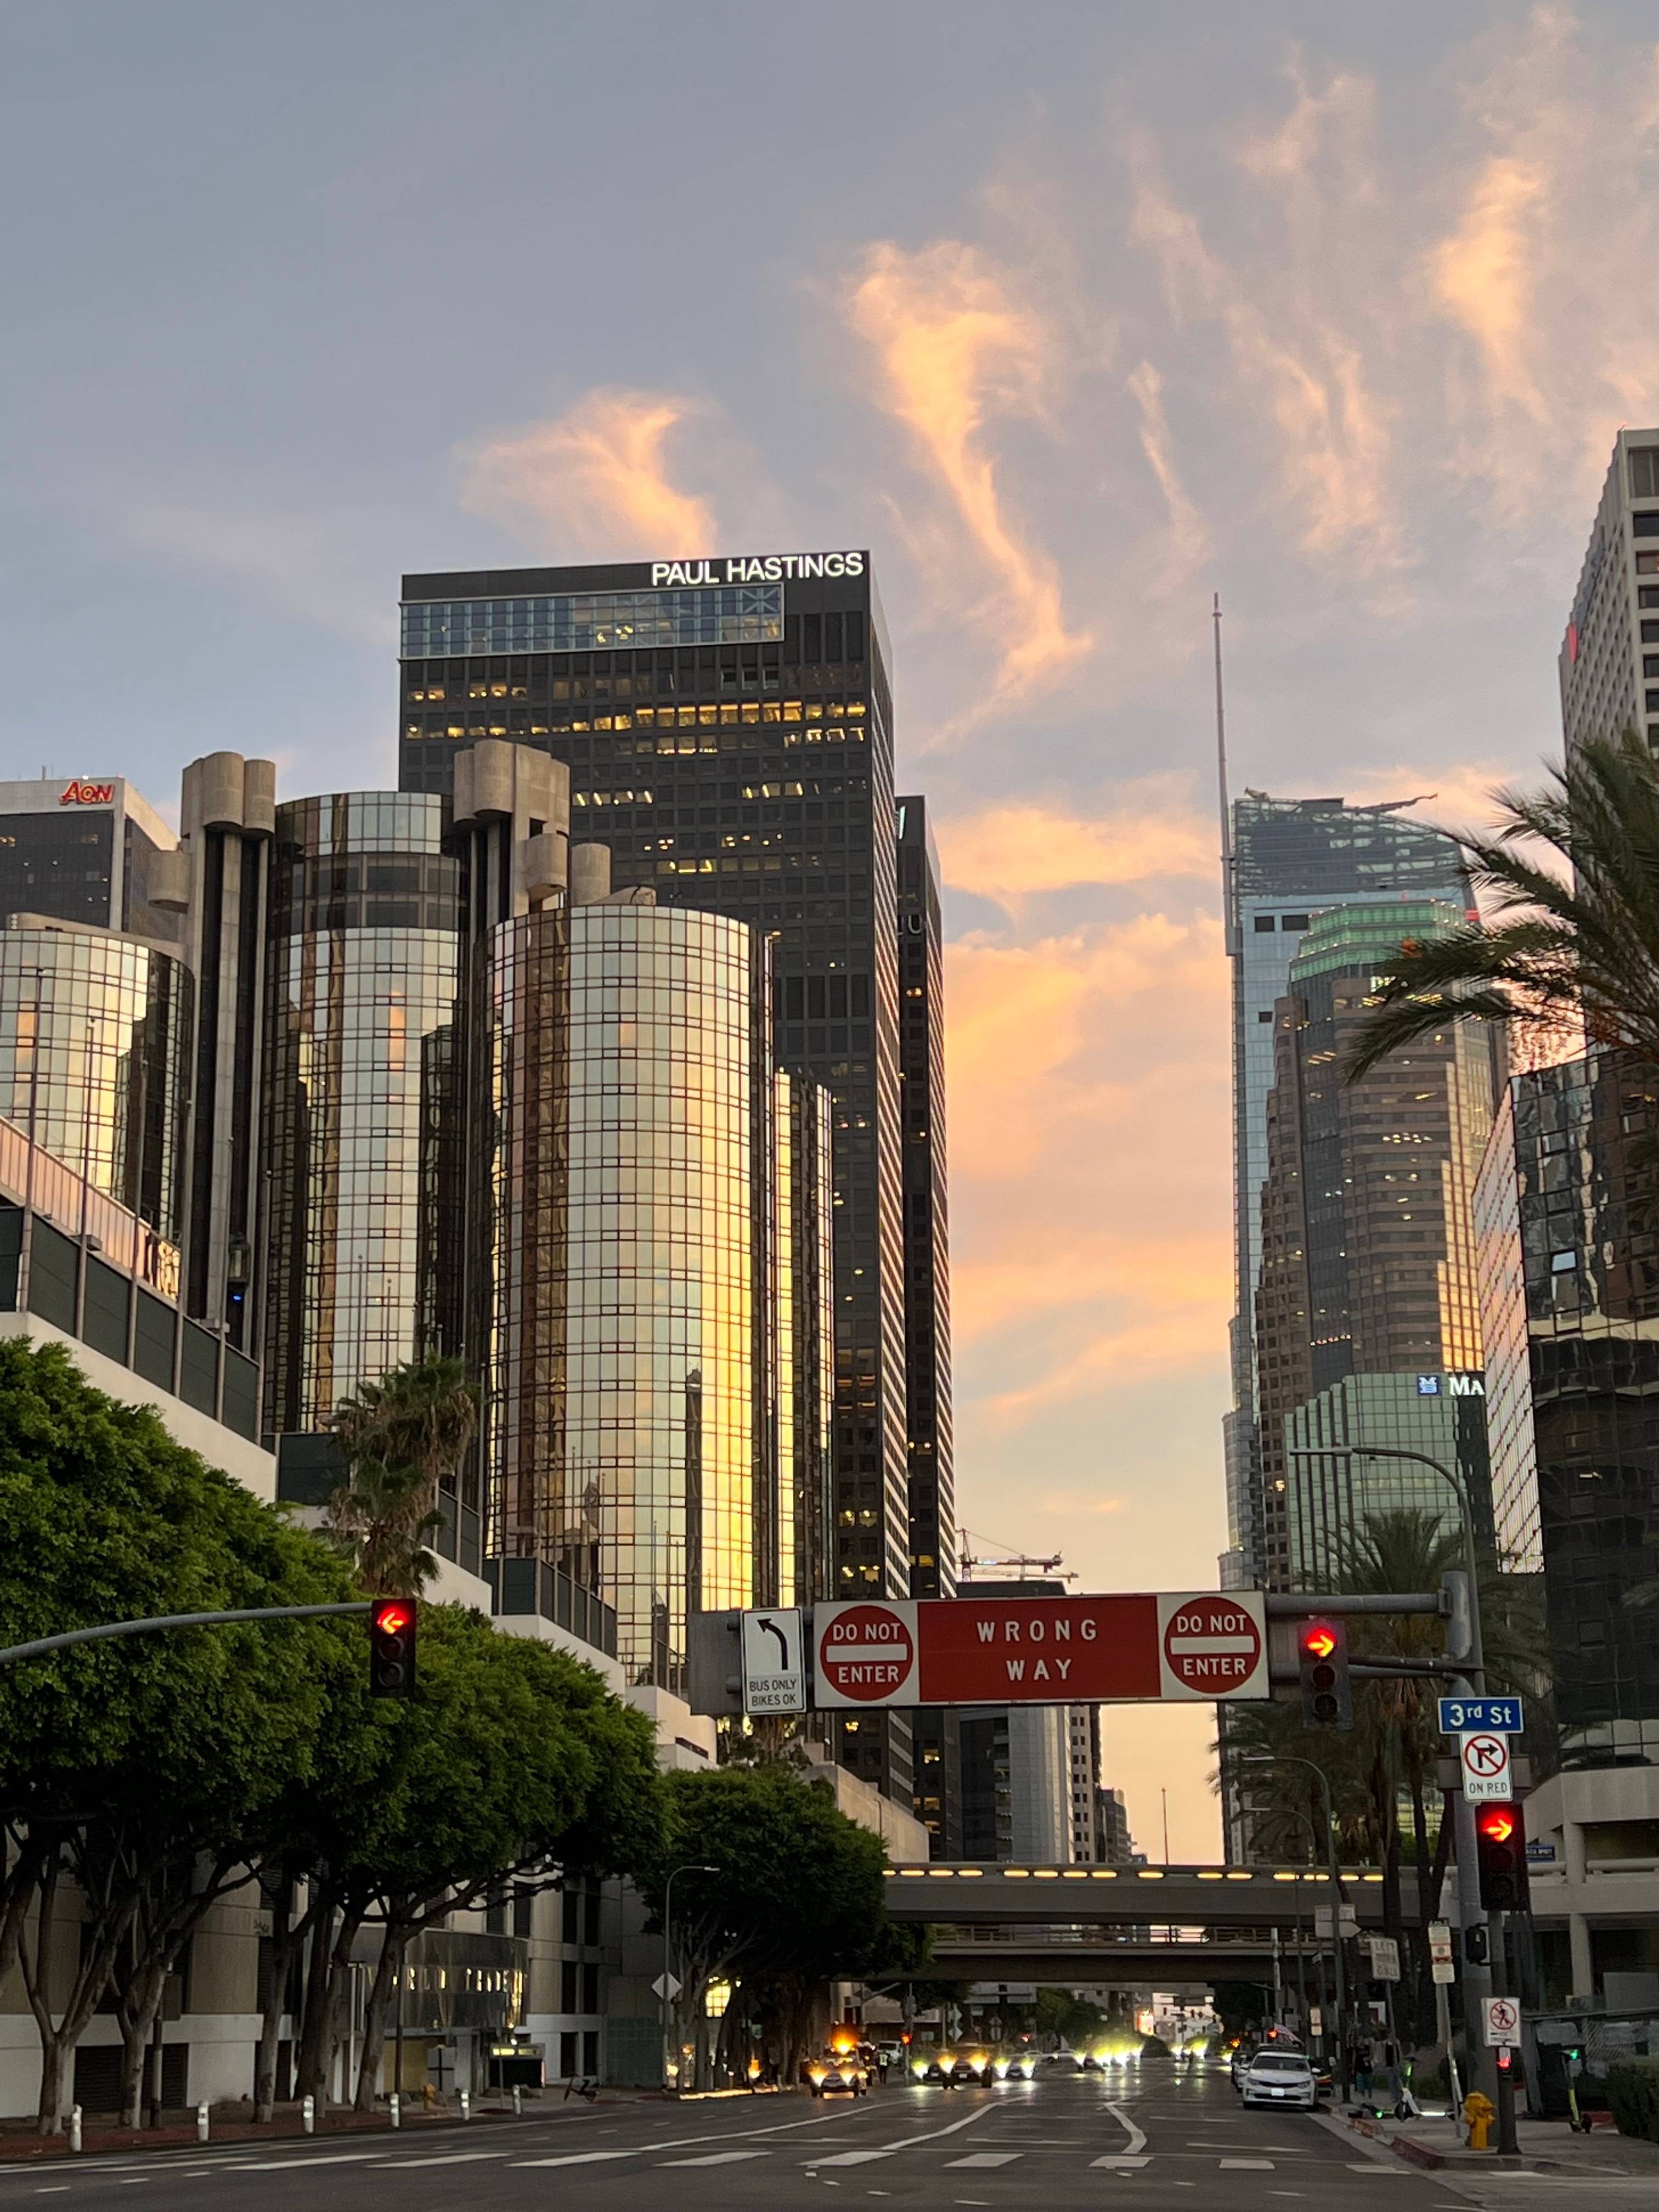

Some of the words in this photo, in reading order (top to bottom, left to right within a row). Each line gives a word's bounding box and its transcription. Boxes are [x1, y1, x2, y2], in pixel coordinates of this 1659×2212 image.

[651, 561, 719, 586] PAUL
[727, 552, 864, 582] HASTINGS
[833, 1624, 857, 1641] DO
[865, 1623, 901, 1640] NOT
[977, 1619, 1097, 1642] WRONG
[1177, 1615, 1202, 1633] DO
[1210, 1615, 1246, 1632] NOT
[838, 1666, 899, 1683] ENTER
[1006, 1658, 1071, 1680] WAY
[1183, 1658, 1246, 1676] ENTER
[749, 1680, 769, 1691] BUS
[772, 1679, 797, 1690] ONLY
[752, 1694, 780, 1707] BIKES
[783, 1694, 796, 1705] OK
[1449, 1704, 1482, 1726] 3rd
[1490, 1706, 1511, 1724] St
[1470, 1782, 1483, 1793] ON
[1487, 1782, 1507, 1793] RED
